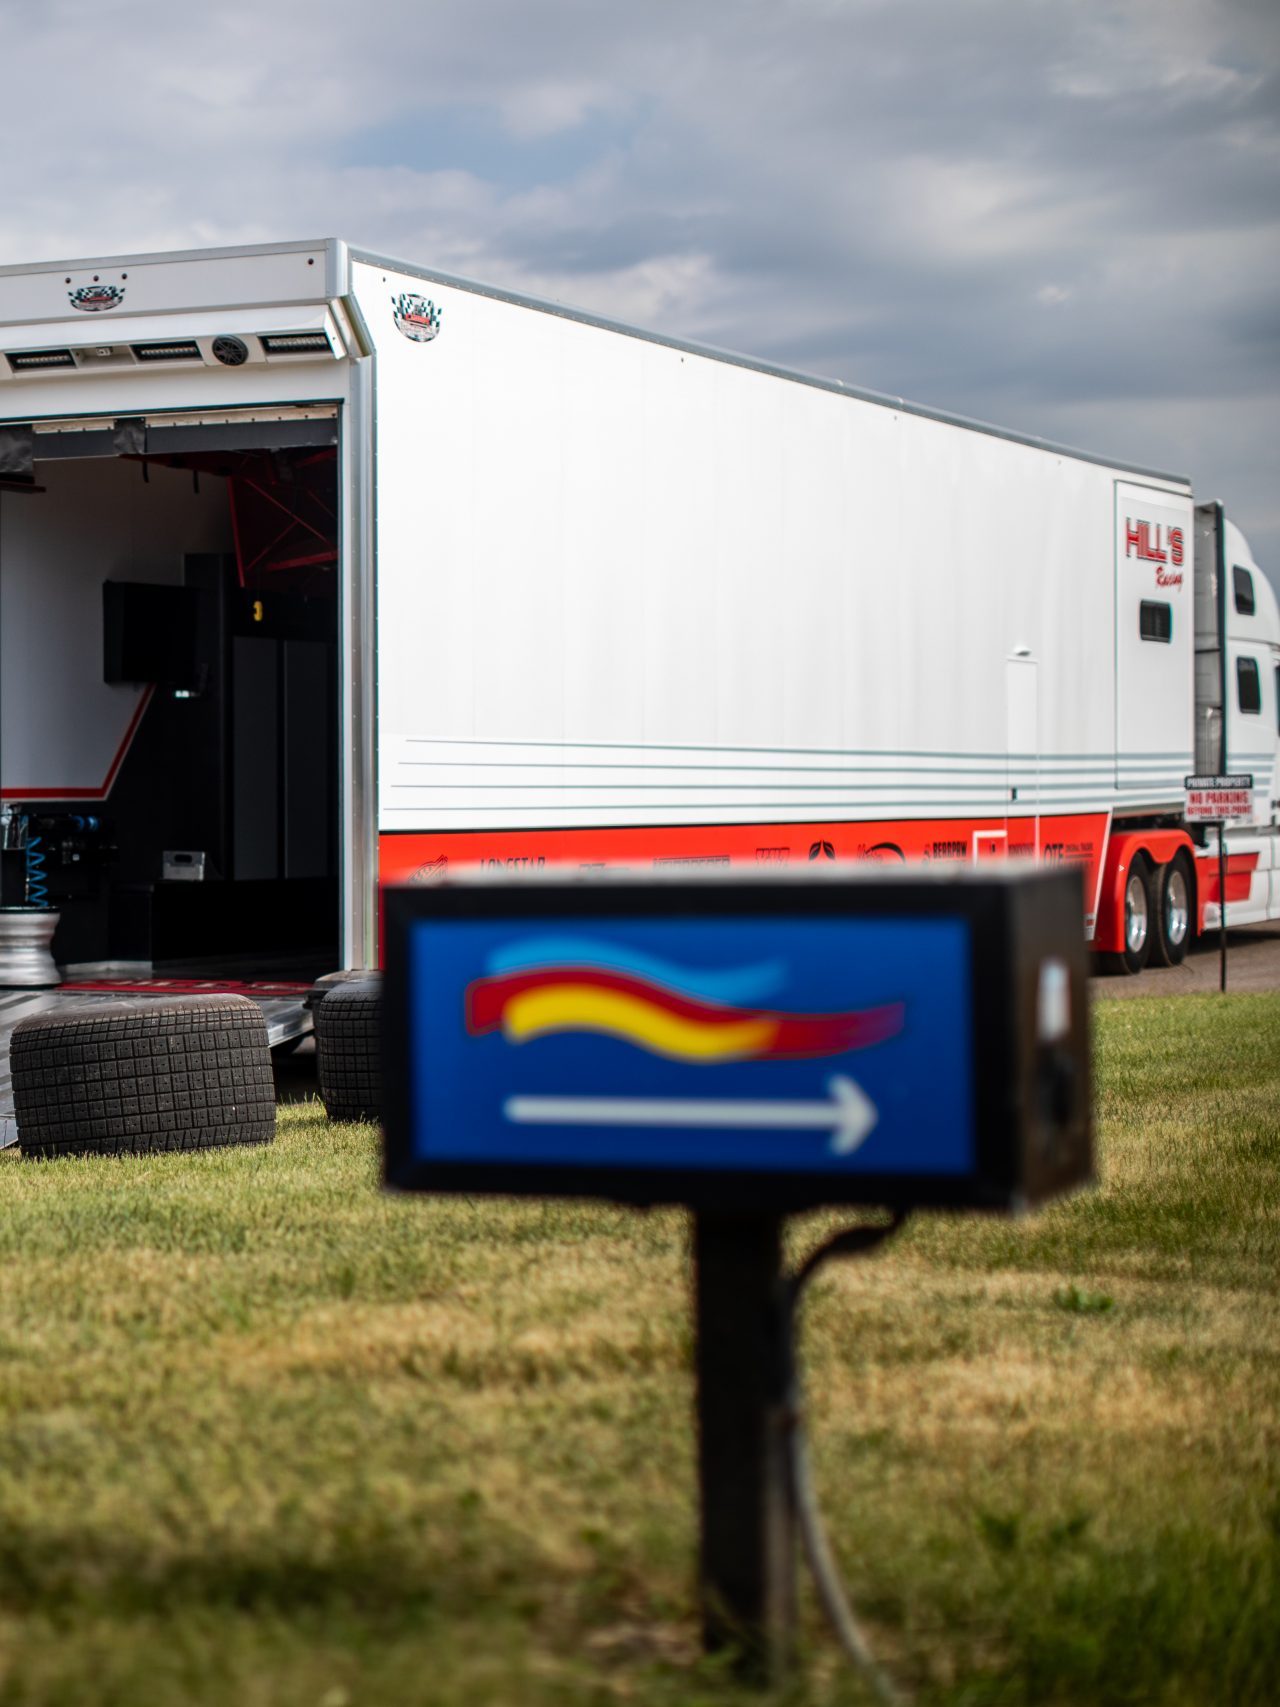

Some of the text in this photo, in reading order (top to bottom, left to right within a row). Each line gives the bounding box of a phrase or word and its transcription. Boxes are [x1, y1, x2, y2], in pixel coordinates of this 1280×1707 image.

[1126, 516, 1184, 566] HILL'S
[1190, 791, 1248, 804] NO PARKING
